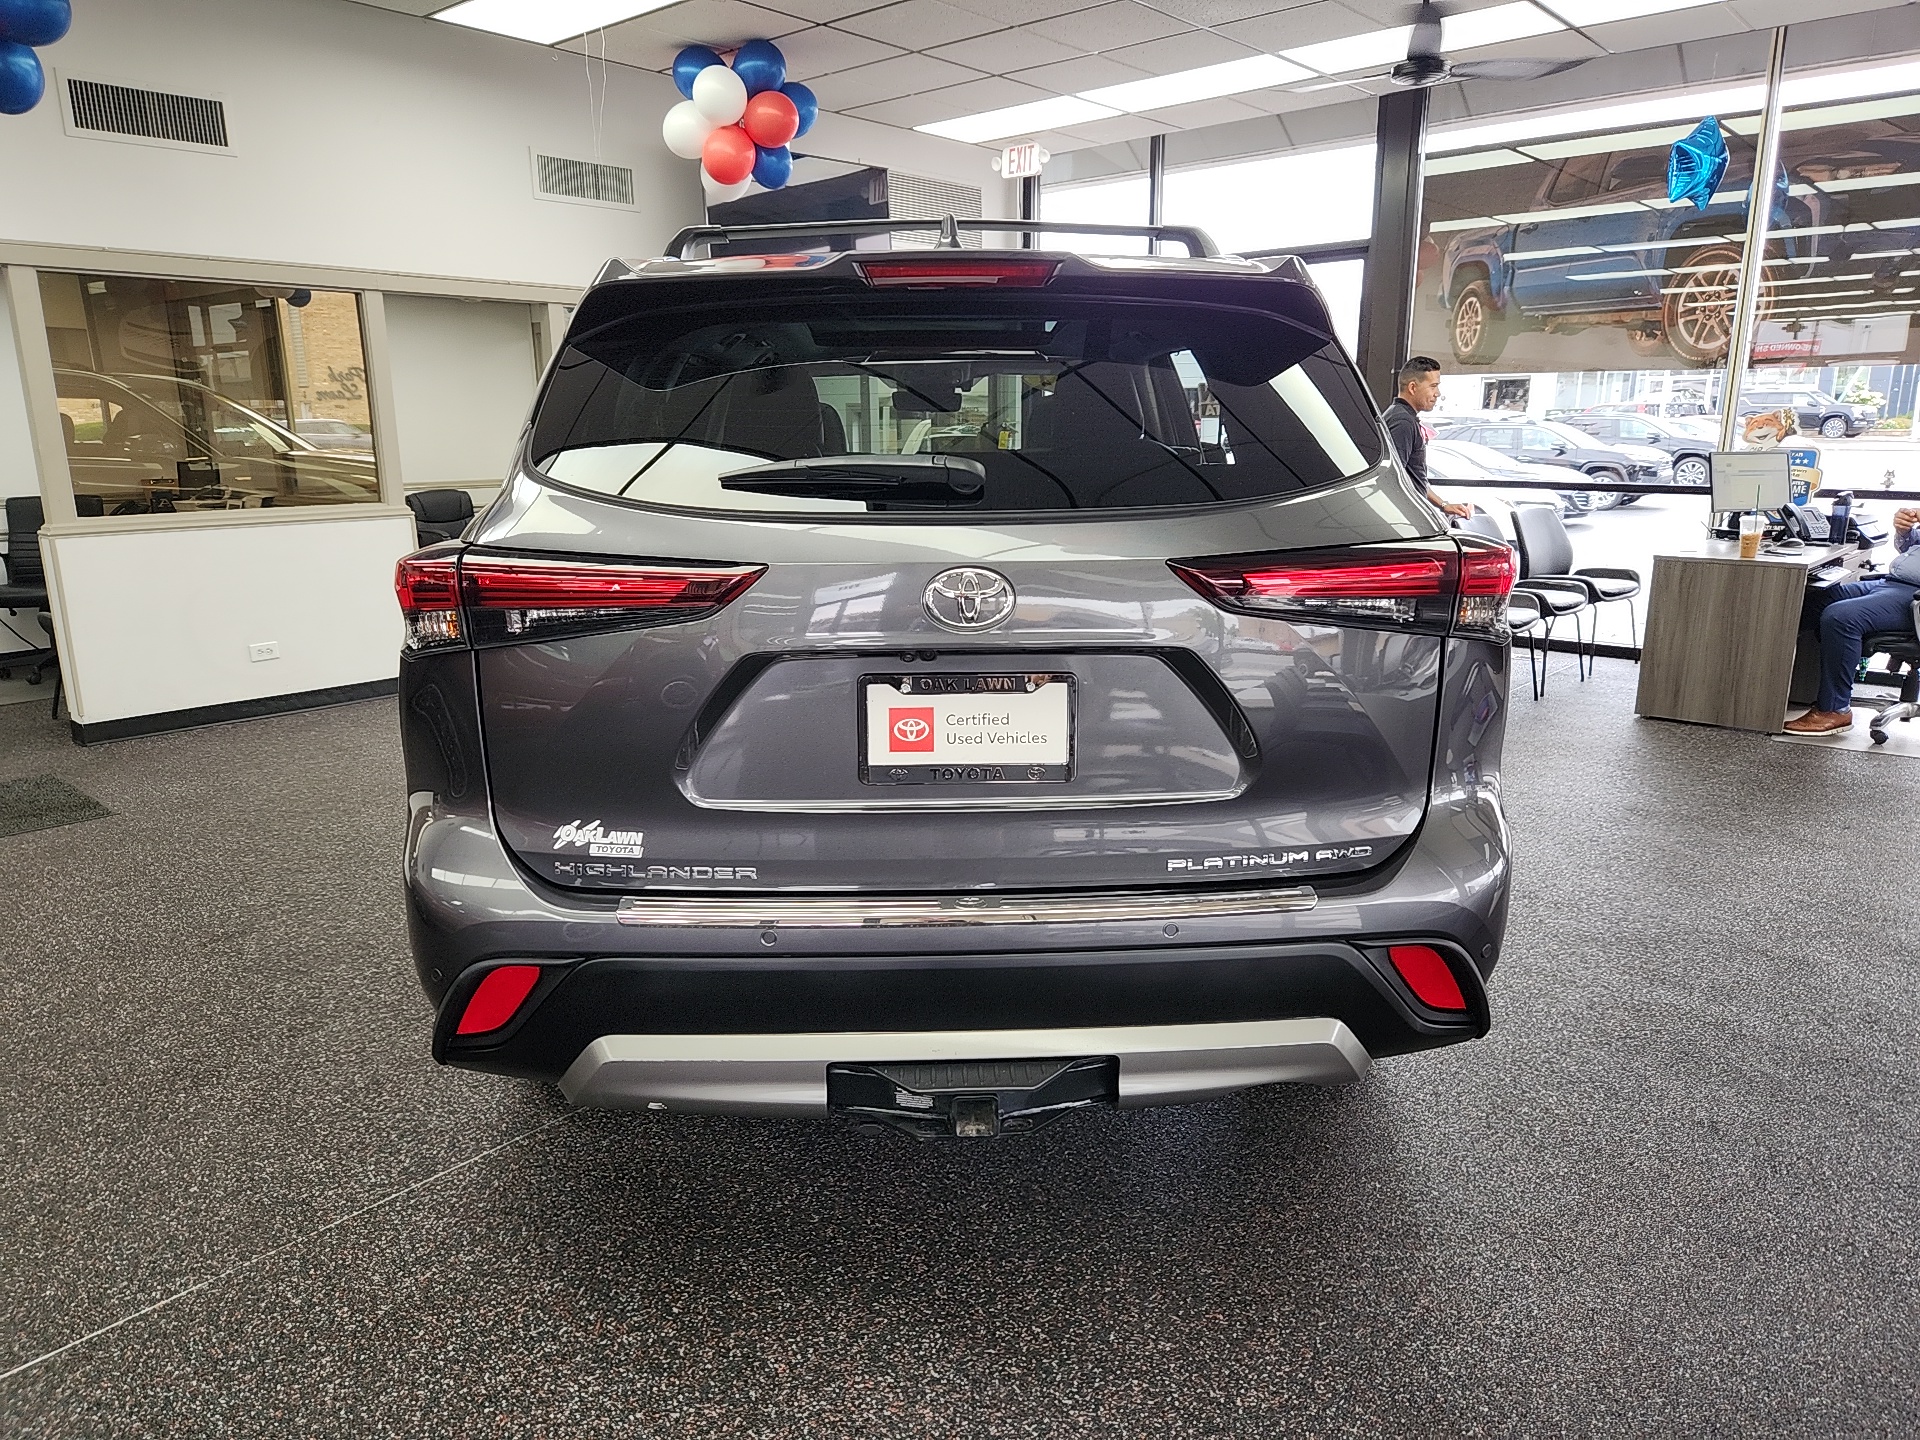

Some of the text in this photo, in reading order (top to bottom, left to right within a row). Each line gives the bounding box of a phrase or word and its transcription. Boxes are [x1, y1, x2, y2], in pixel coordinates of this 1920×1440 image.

[1008, 144, 1035, 174] EXIT
[920, 677, 1016, 691] OAK LAWN
[945, 712, 1010, 726] Certified
[946, 730, 1048, 745] Used Vehicles
[929, 766, 1005, 780] TOYOTA
[595, 845, 635, 854] TOYOTA
[1166, 845, 1373, 872] PLATINUM AWD
[554, 861, 758, 880] HIGHLANDER
